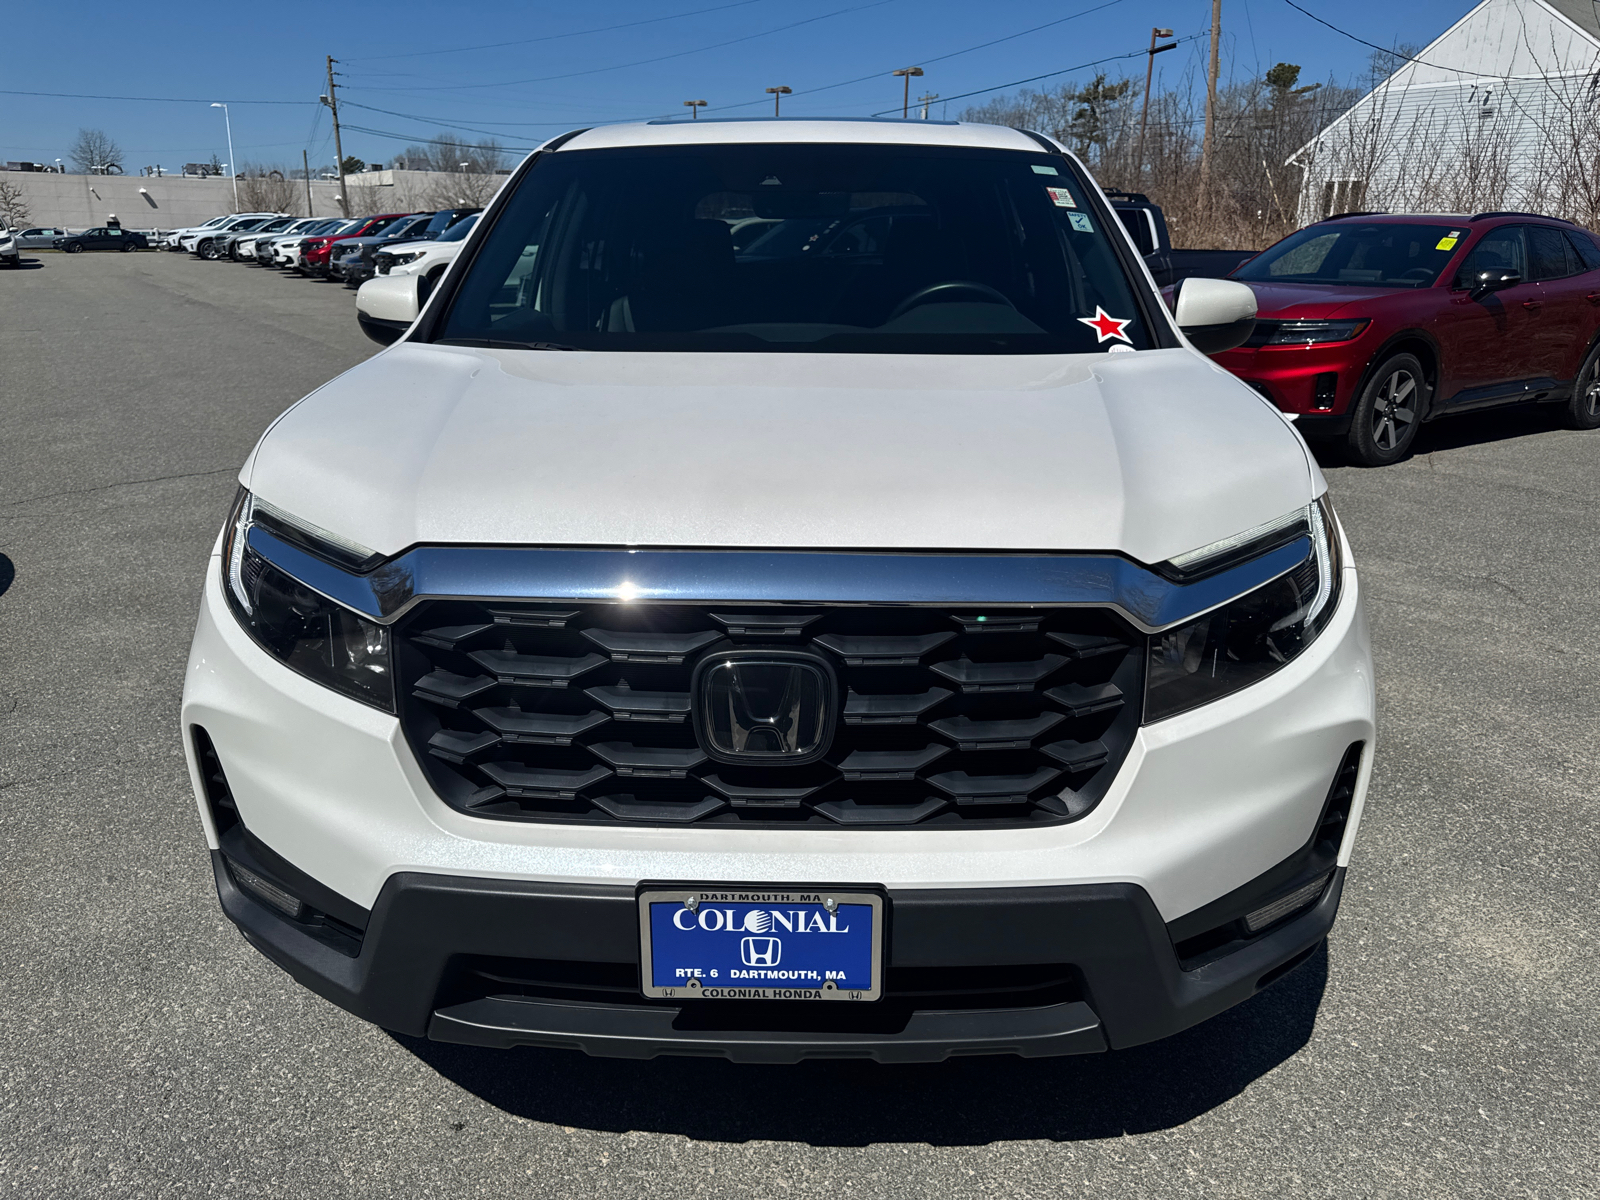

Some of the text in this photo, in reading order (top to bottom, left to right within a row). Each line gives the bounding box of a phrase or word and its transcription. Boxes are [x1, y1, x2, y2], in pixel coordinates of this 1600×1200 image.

[700, 893, 822, 902] DARTMOUTH, MA
[673, 909, 849, 933] COLONIAL
[675, 968, 719, 978] RTE. 6
[730, 969, 847, 981] DARTMOUTH, MA
[701, 988, 822, 999] COLONIAL HONDA
